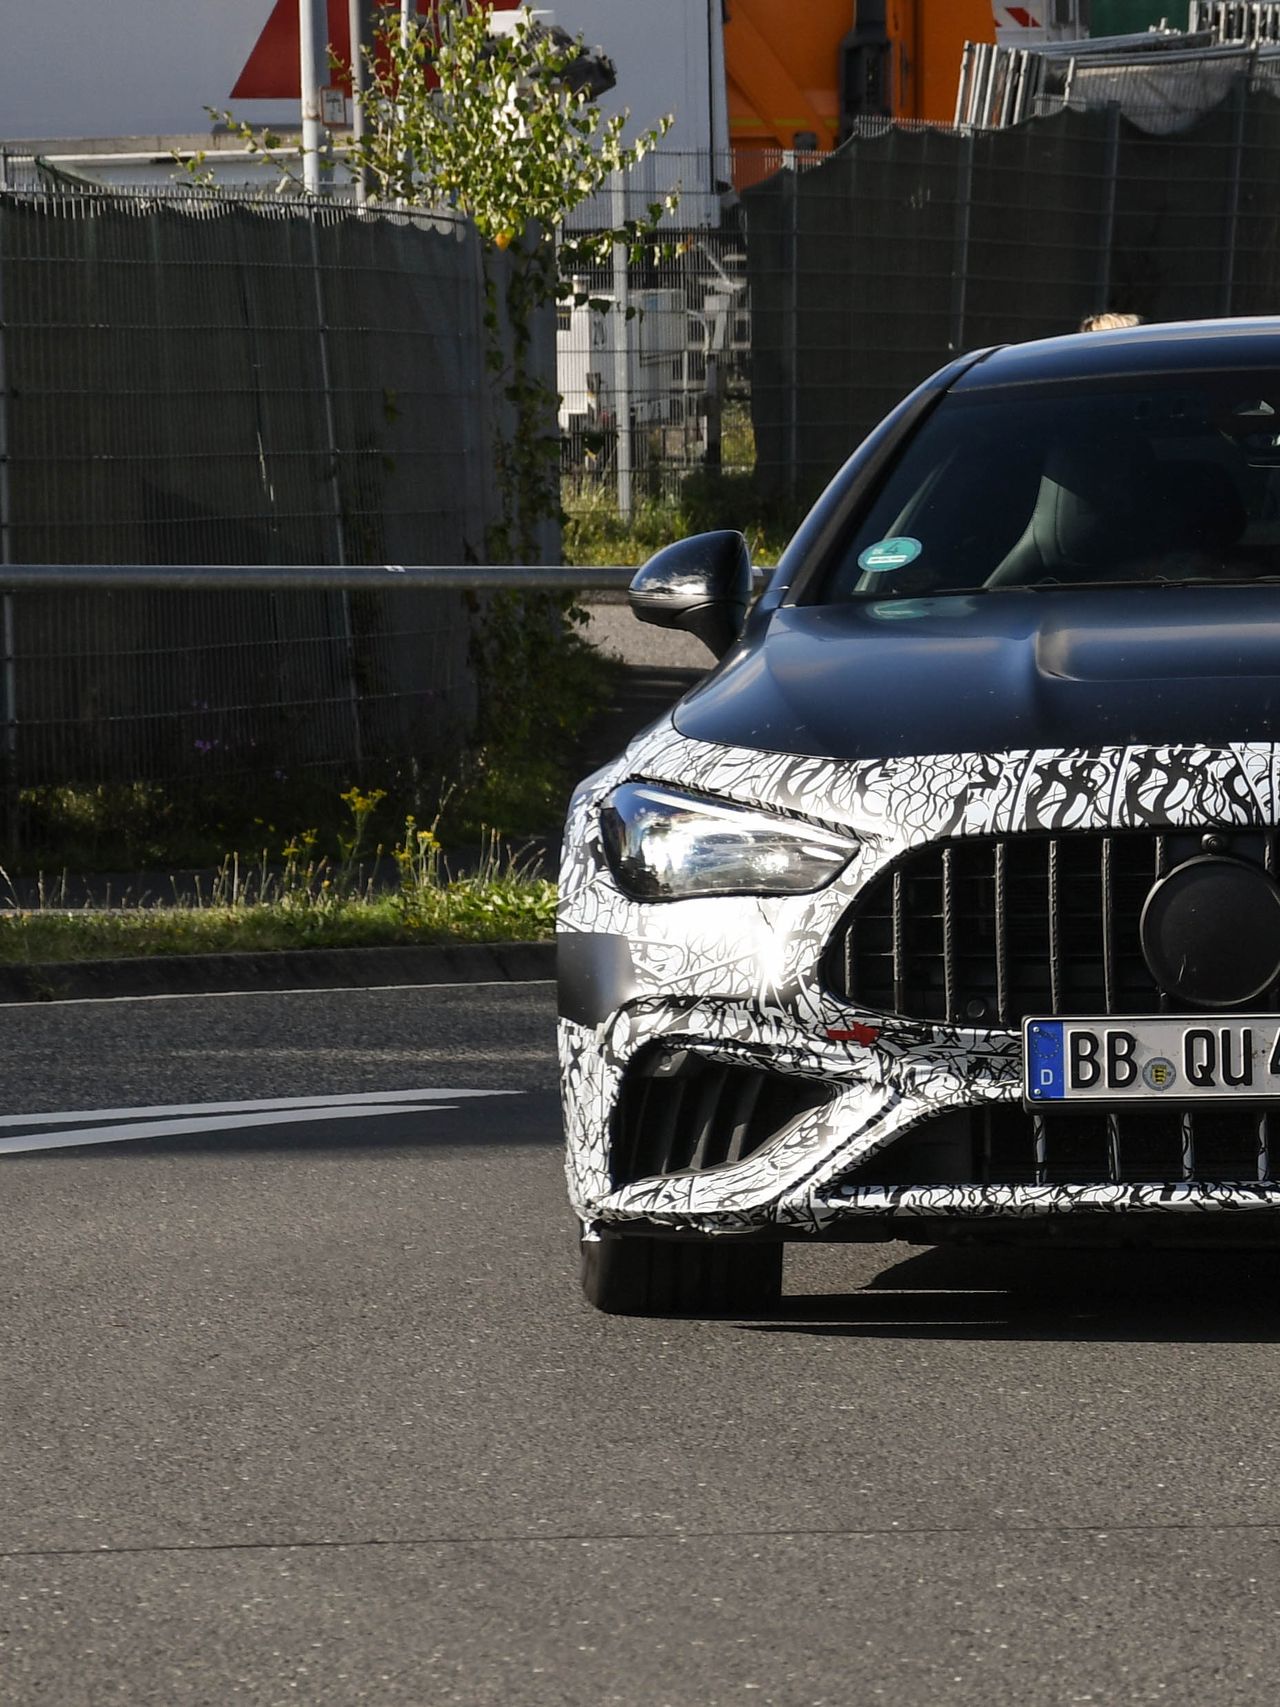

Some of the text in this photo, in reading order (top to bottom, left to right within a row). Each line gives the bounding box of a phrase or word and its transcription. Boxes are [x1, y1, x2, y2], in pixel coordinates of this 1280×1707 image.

[1040, 1068, 1053, 1086] D
[1069, 1029, 1138, 1089] BB
[1183, 1027, 1254, 1087] QU
